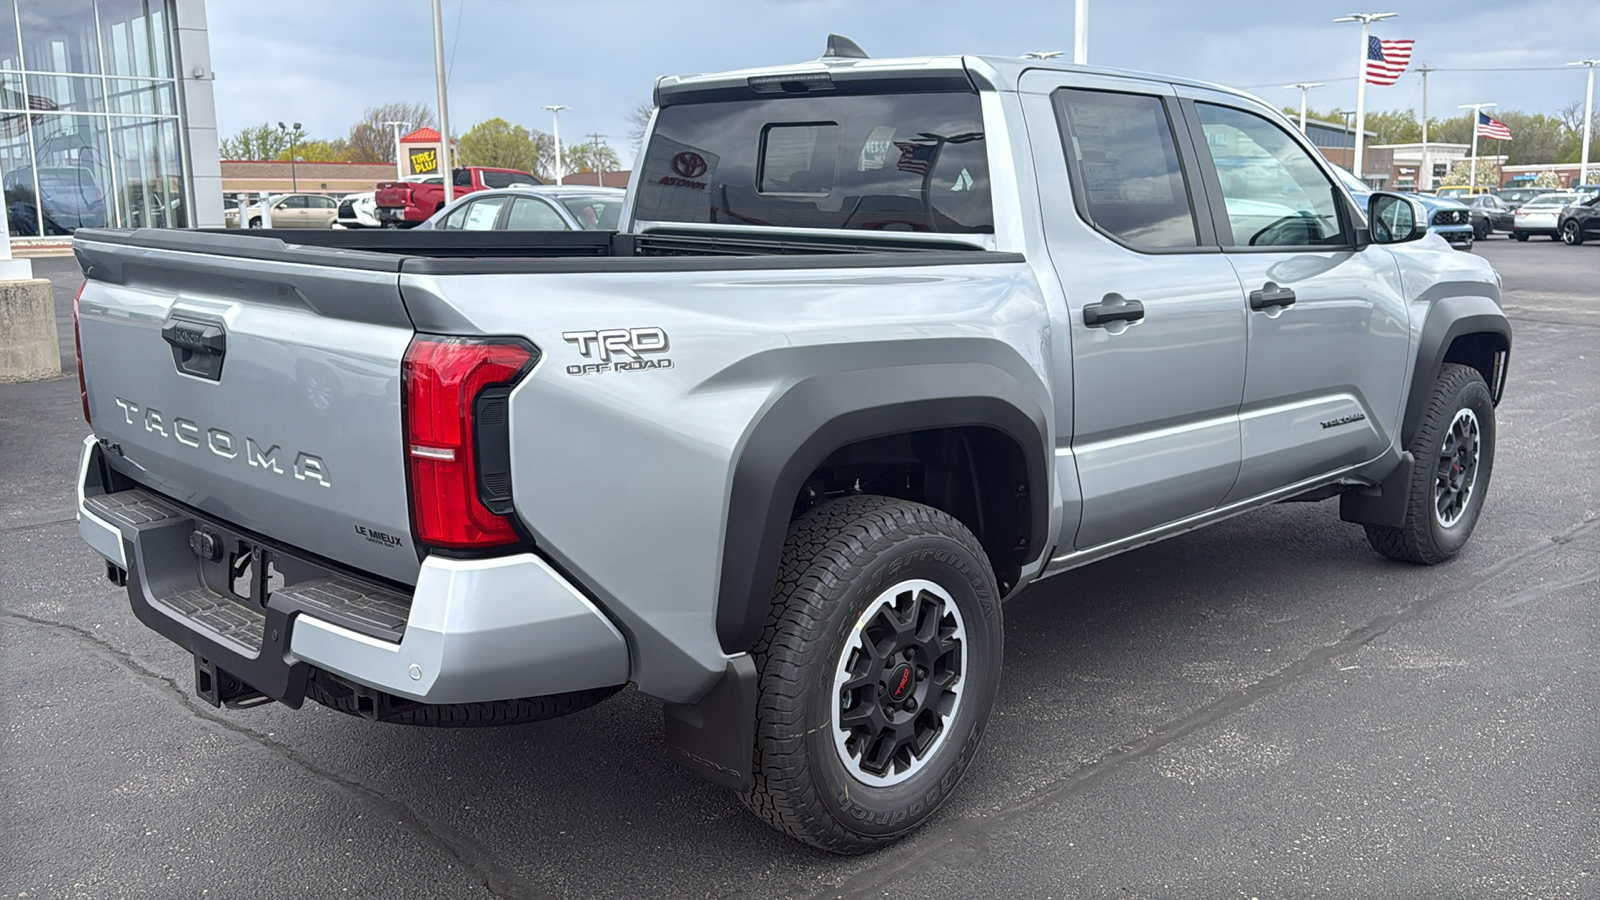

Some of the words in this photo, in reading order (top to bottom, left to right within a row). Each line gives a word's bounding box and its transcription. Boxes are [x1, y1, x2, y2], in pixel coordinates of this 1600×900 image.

[411, 150, 436, 165] TIRES
[414, 159, 437, 174] PLUS
[562, 327, 670, 363] TRD
[566, 362, 611, 376] OFF
[614, 358, 675, 373] ROAD
[116, 396, 331, 488] TACOMA
[354, 524, 368, 536] LE
[368, 529, 403, 547] MIEUX
[895, 667, 910, 697] TRD
